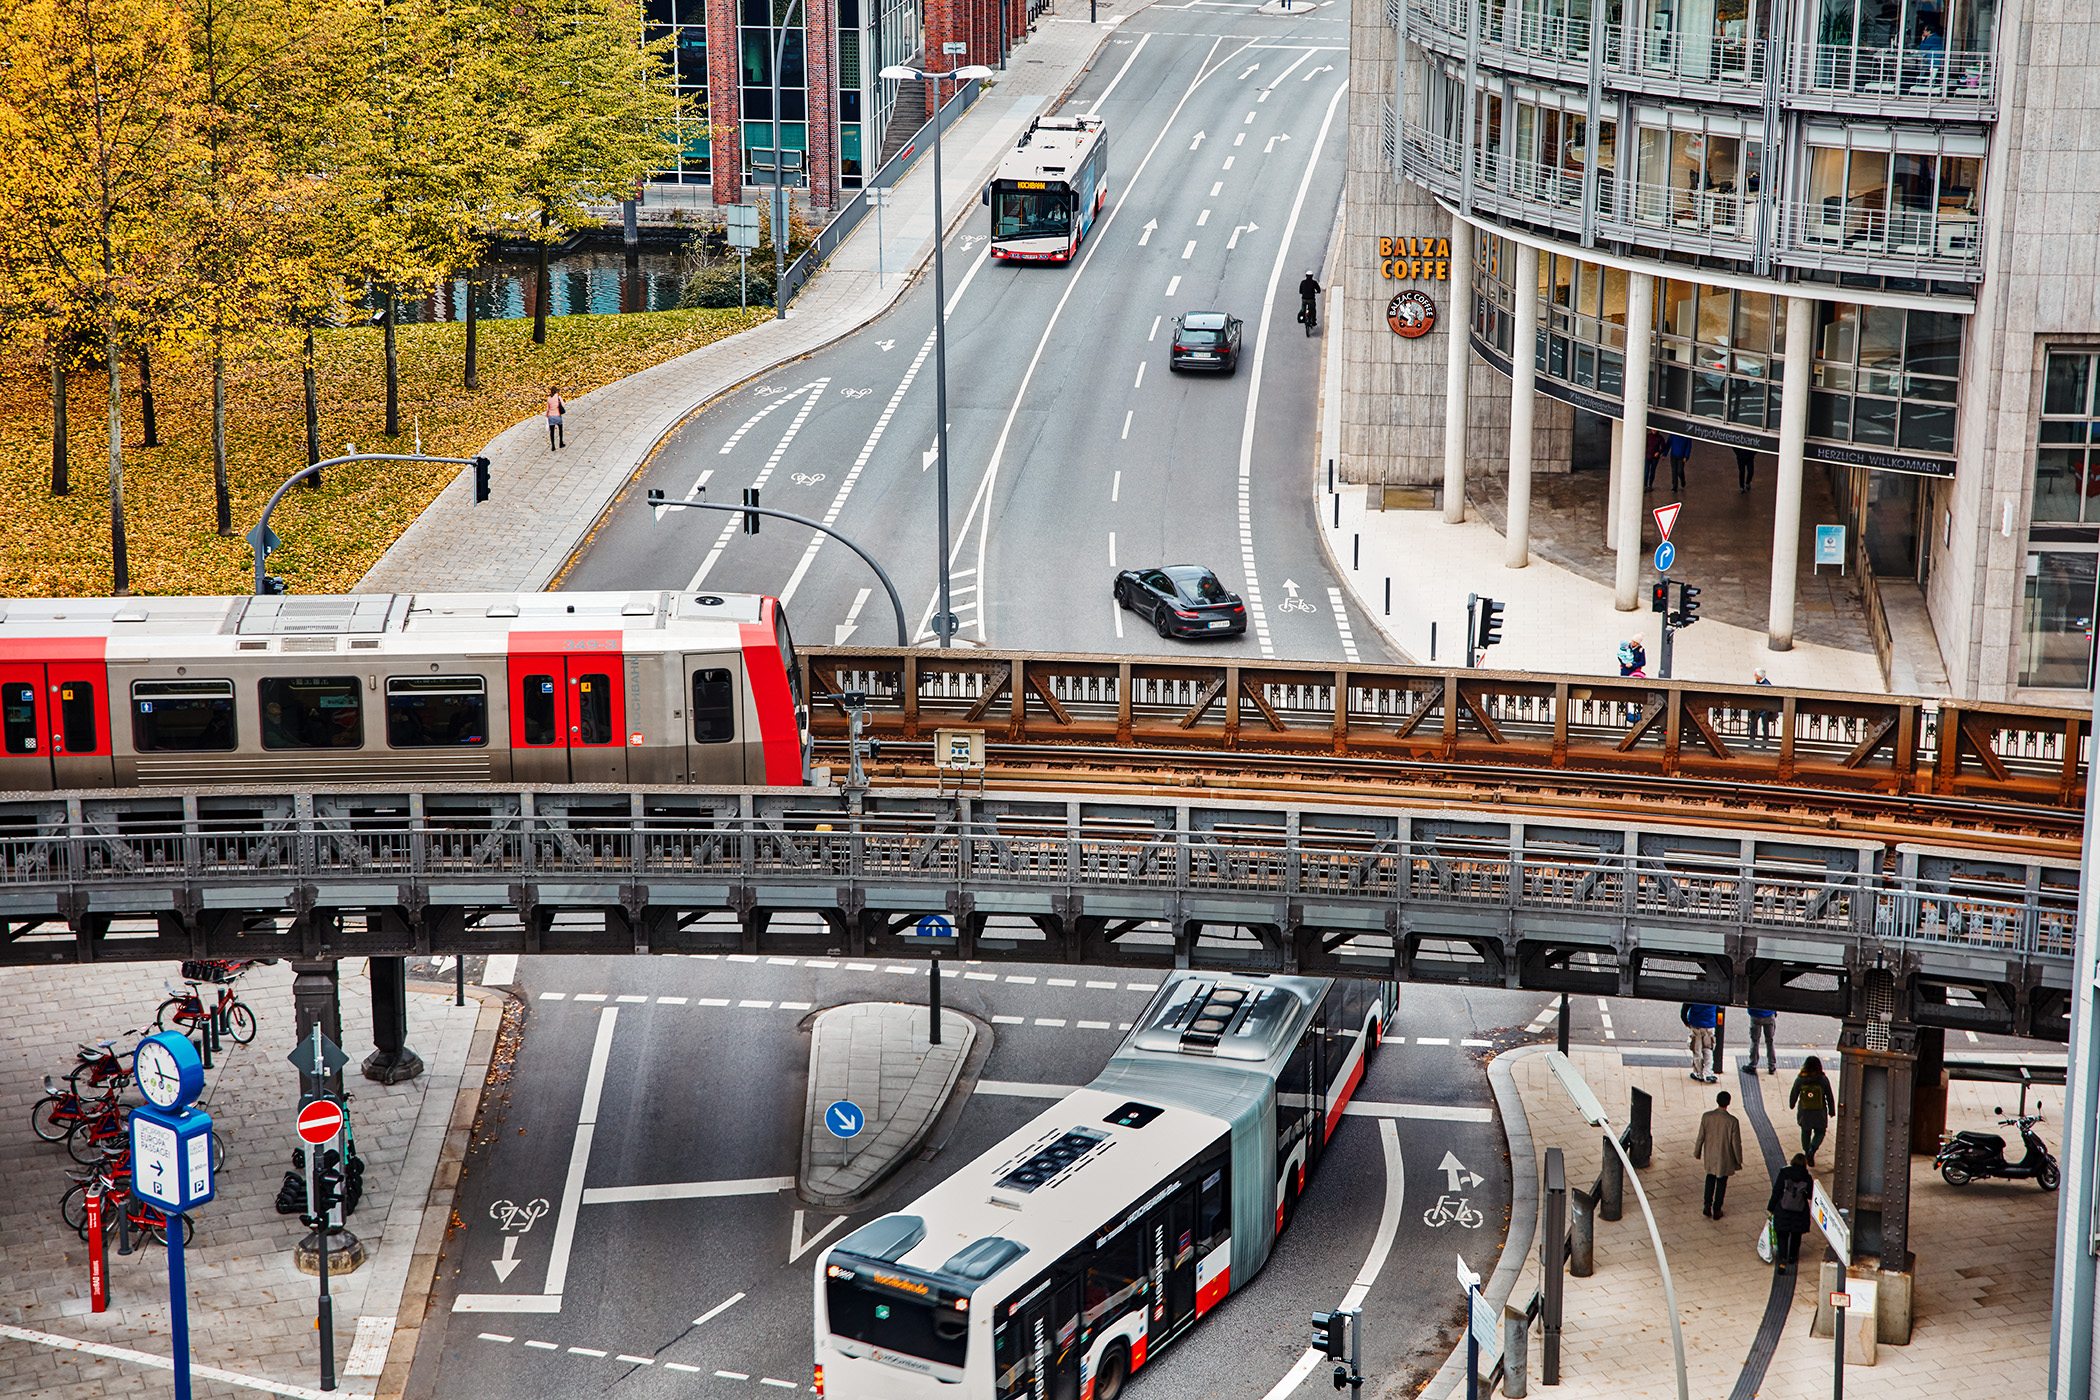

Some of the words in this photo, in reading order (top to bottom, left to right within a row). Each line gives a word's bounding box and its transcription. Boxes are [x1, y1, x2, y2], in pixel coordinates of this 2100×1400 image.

[1017, 181, 1046, 190] HOCHBAHN
[1379, 237, 1451, 258] BALZA
[1380, 259, 1452, 280] COFFE
[1389, 292, 1412, 316] BALZAC
[1413, 293, 1434, 317] COFFEE
[1694, 425, 1761, 447] HypoVereinsbank
[1817, 448, 1864, 463] HERZLICH
[1869, 455, 1941, 473] WILLKOMMEN
[563, 639, 617, 650] 349-3
[630, 656, 641, 731] HOCHBAHN
[140, 1132, 166, 1147] EUROPA
[1155, 1224, 1163, 1306] HOCHBAHN
